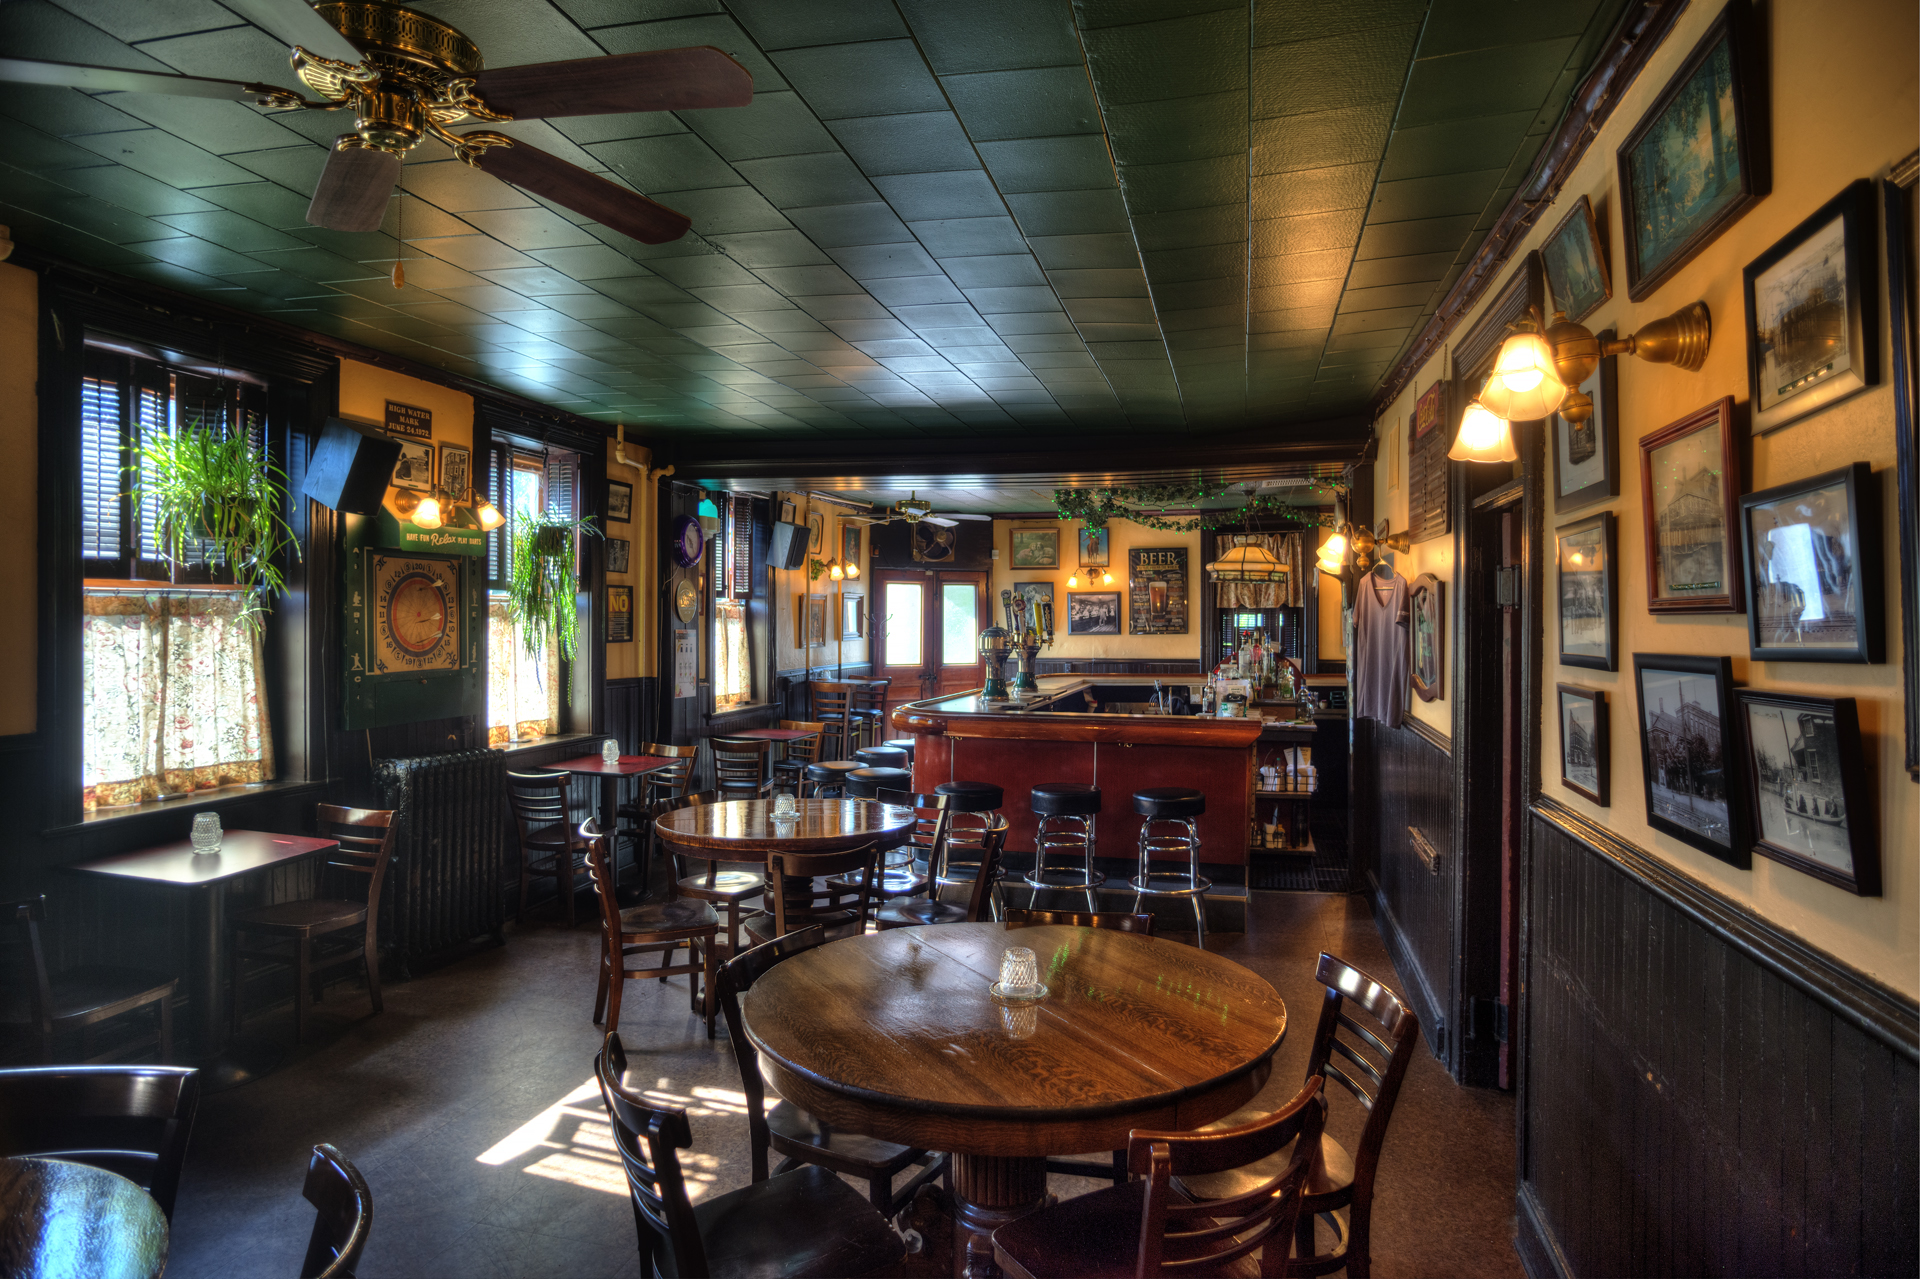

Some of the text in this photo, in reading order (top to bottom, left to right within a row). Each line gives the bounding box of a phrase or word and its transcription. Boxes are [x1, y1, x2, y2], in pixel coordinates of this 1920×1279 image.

[388, 403, 431, 420] HIGH WATER
[388, 422, 406, 432] JUNE
[399, 415, 420, 426] MARK
[406, 532, 482, 547] HAVE FUN Relax PLAY DARTS
[1139, 552, 1178, 566] BEER
[610, 595, 629, 612] NO
